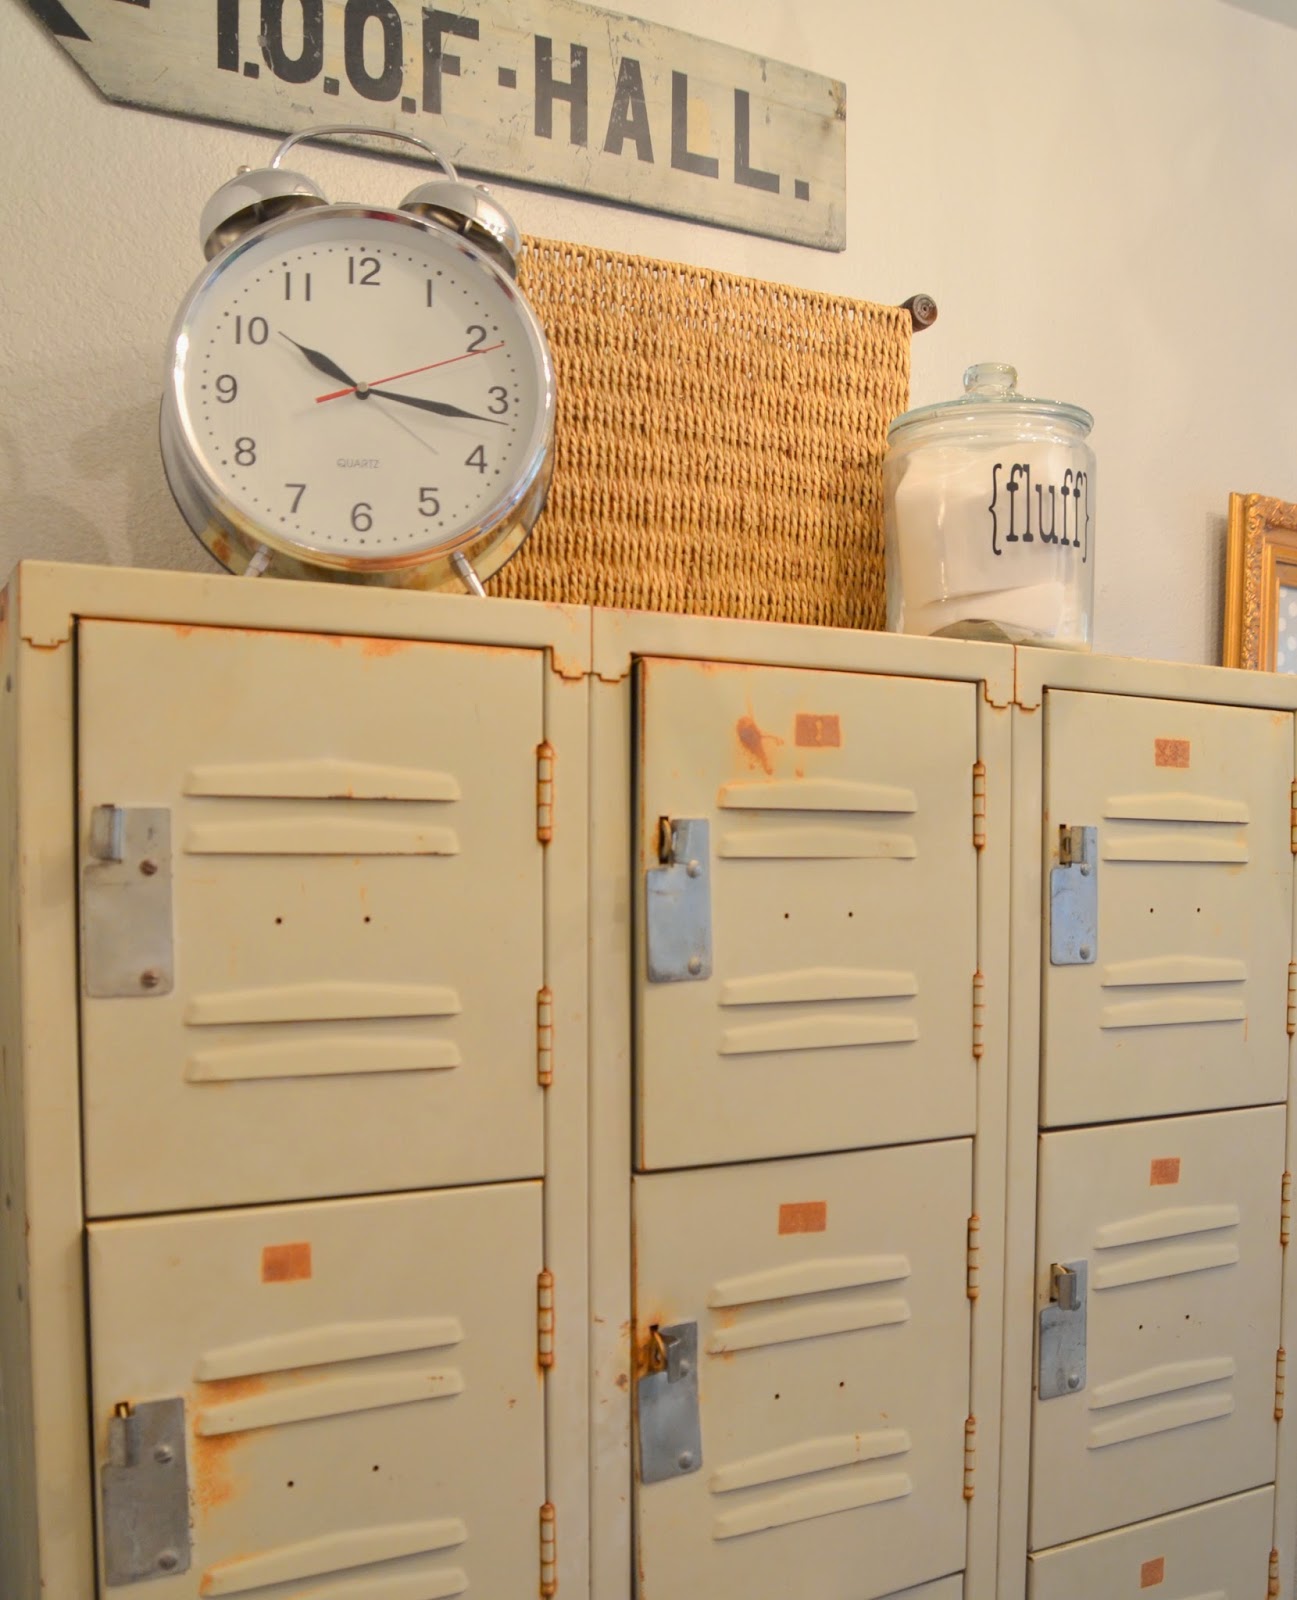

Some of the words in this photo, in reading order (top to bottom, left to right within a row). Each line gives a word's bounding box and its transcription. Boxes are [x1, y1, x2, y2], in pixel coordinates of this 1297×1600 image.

[348, 256, 382, 286] 12
[285, 271, 312, 302] 11
[426, 278, 433, 308] 1
[235, 315, 269, 345] 10
[465, 324, 488, 354] 2
[215, 374, 239, 404] 9
[488, 386, 509, 415] 3
[234, 437, 257, 467] 8
[336, 458, 380, 469] QUARTZ
[465, 444, 488, 474] 4
[285, 483, 307, 514] 7
[418, 487, 441, 517] 5
[351, 502, 373, 532] 6
